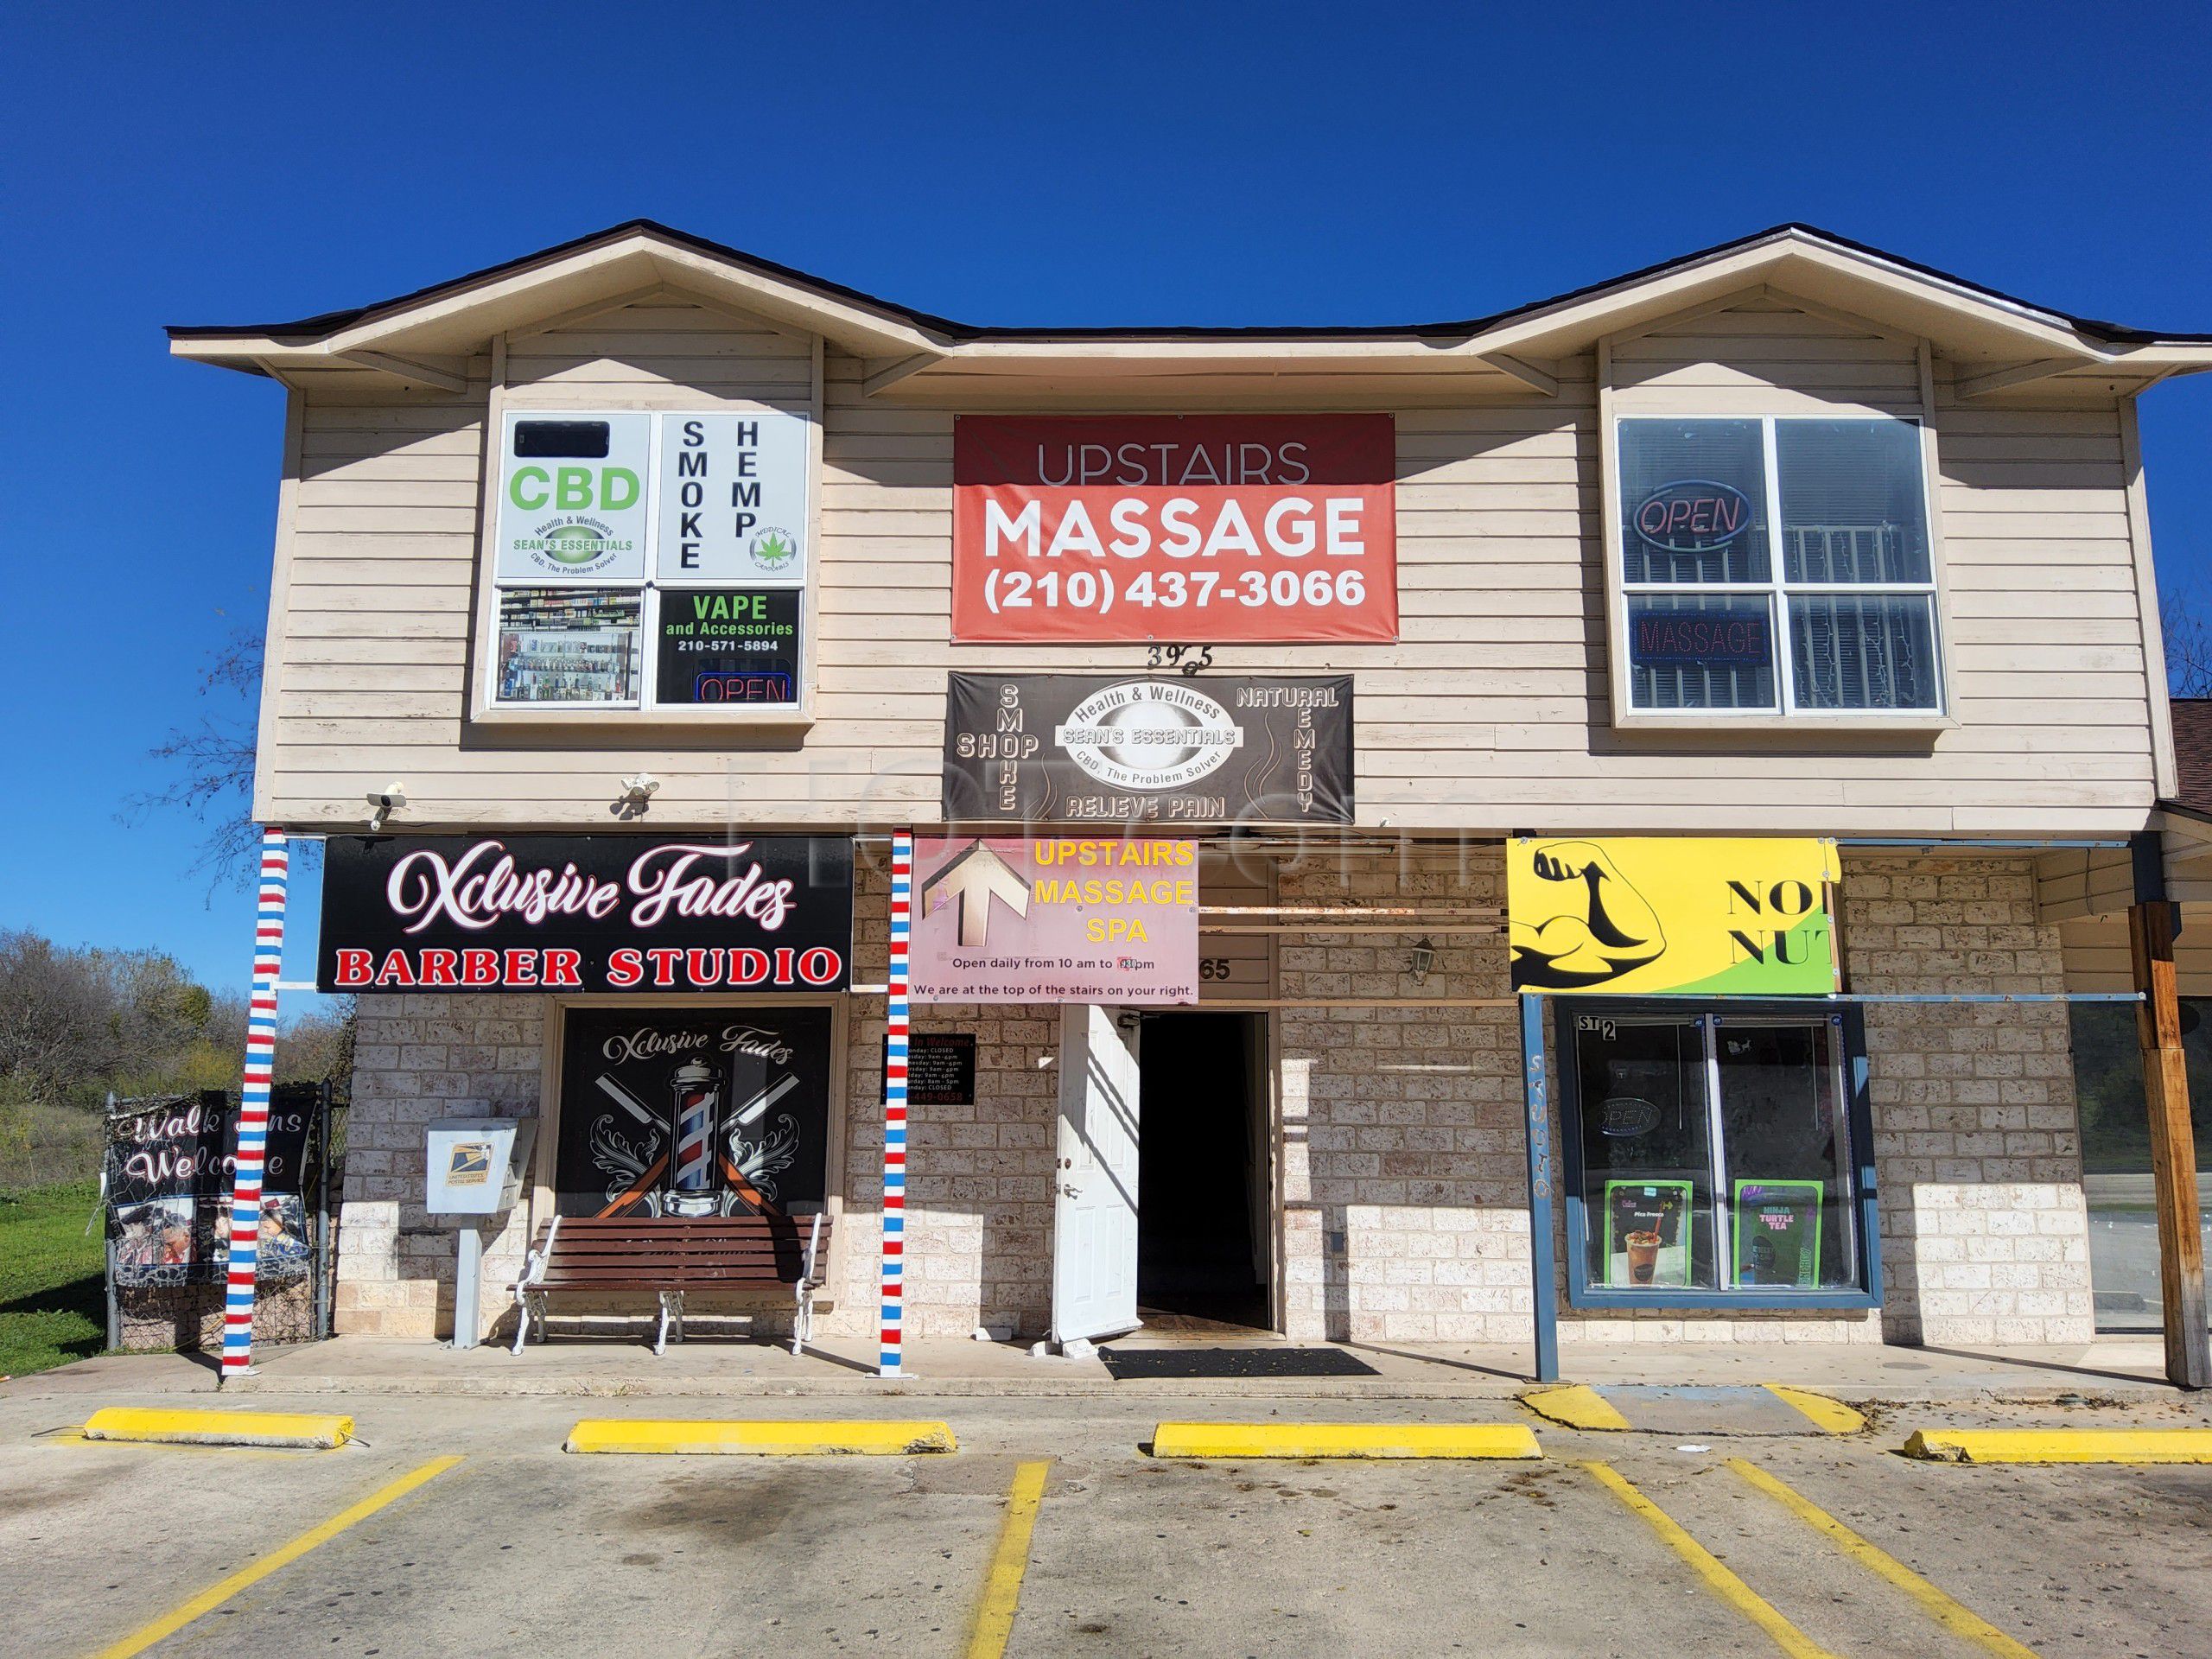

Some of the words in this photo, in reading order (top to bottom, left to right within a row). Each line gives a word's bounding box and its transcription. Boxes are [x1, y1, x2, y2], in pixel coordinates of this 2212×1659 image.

[1038, 442, 1310, 486] UPSTAIRS
[510, 467, 639, 511] CBD
[731, 421, 761, 537] HEMP
[677, 421, 708, 569] SMOKE
[534, 518, 563, 536] Health
[566, 516, 573, 524] &
[576, 515, 614, 537] Wellness
[985, 497, 1364, 558] MASSAGE
[1641, 498, 1739, 534] OPEN
[513, 539, 556, 550] SEAN'S
[561, 539, 632, 550] ESSENTIALS
[547, 563, 561, 573] The
[595, 553, 617, 570] Solver
[984, 569, 1116, 614] (210)
[1125, 569, 1365, 607] 437-3066
[693, 595, 767, 620] VAPE
[666, 622, 694, 636] and
[700, 622, 793, 636] Accessories
[1641, 621, 1762, 654] MASSAGE
[677, 640, 779, 652] 210-571-5894
[701, 677, 785, 702] OPEN
[1236, 688, 1339, 709] NATURAL
[1073, 690, 1125, 723] Health
[1132, 686, 1142, 702] &
[1149, 685, 1222, 720] Wellness
[956, 733, 1039, 760] SHOP
[1063, 728, 1123, 746] SEAN'S
[1131, 728, 1236, 746] ESSENTIALS
[1108, 767, 1127, 781] The
[1133, 773, 1183, 785] Problem
[1186, 752, 1222, 777] Solver
[1066, 796, 1159, 818] RELIEVE
[1168, 796, 1225, 818] PAIN
[1035, 841, 1194, 866] UPSTAIRS
[386, 840, 620, 934] Xclusive
[627, 841, 798, 931] Fades
[1035, 880, 1193, 905] MASSAGE
[1086, 918, 1148, 943] SPA
[335, 948, 582, 987] BARBER
[607, 947, 842, 987] STUDIO
[952, 958, 987, 971] Open
[990, 958, 1021, 971] daily
[1025, 958, 1054, 969] from
[1058, 959, 1072, 969] 10
[1099, 959, 1112, 969] to
[1198, 960, 1230, 980] 65
[914, 985, 935, 996] We
[938, 988, 958, 996] are
[963, 986, 975, 996] at
[978, 985, 999, 995] the
[1002, 986, 1024, 998] top
[1028, 985, 1041, 995] of
[1046, 985, 1065, 995] the
[1070, 985, 1103, 995] stairs
[1108, 988, 1123, 996] on
[1127, 988, 1155, 998] your
[1160, 984, 1194, 998] right.
[1580, 1017, 1599, 1030] ST
[1605, 1021, 1615, 1039] 2
[720, 1025, 793, 1065] Fades
[927, 1038, 969, 1046] Welcome
[125, 1145, 283, 1183] Welcoe
[1763, 1206, 1790, 1215] NINJA
[1768, 1222, 1787, 1230] TEA
